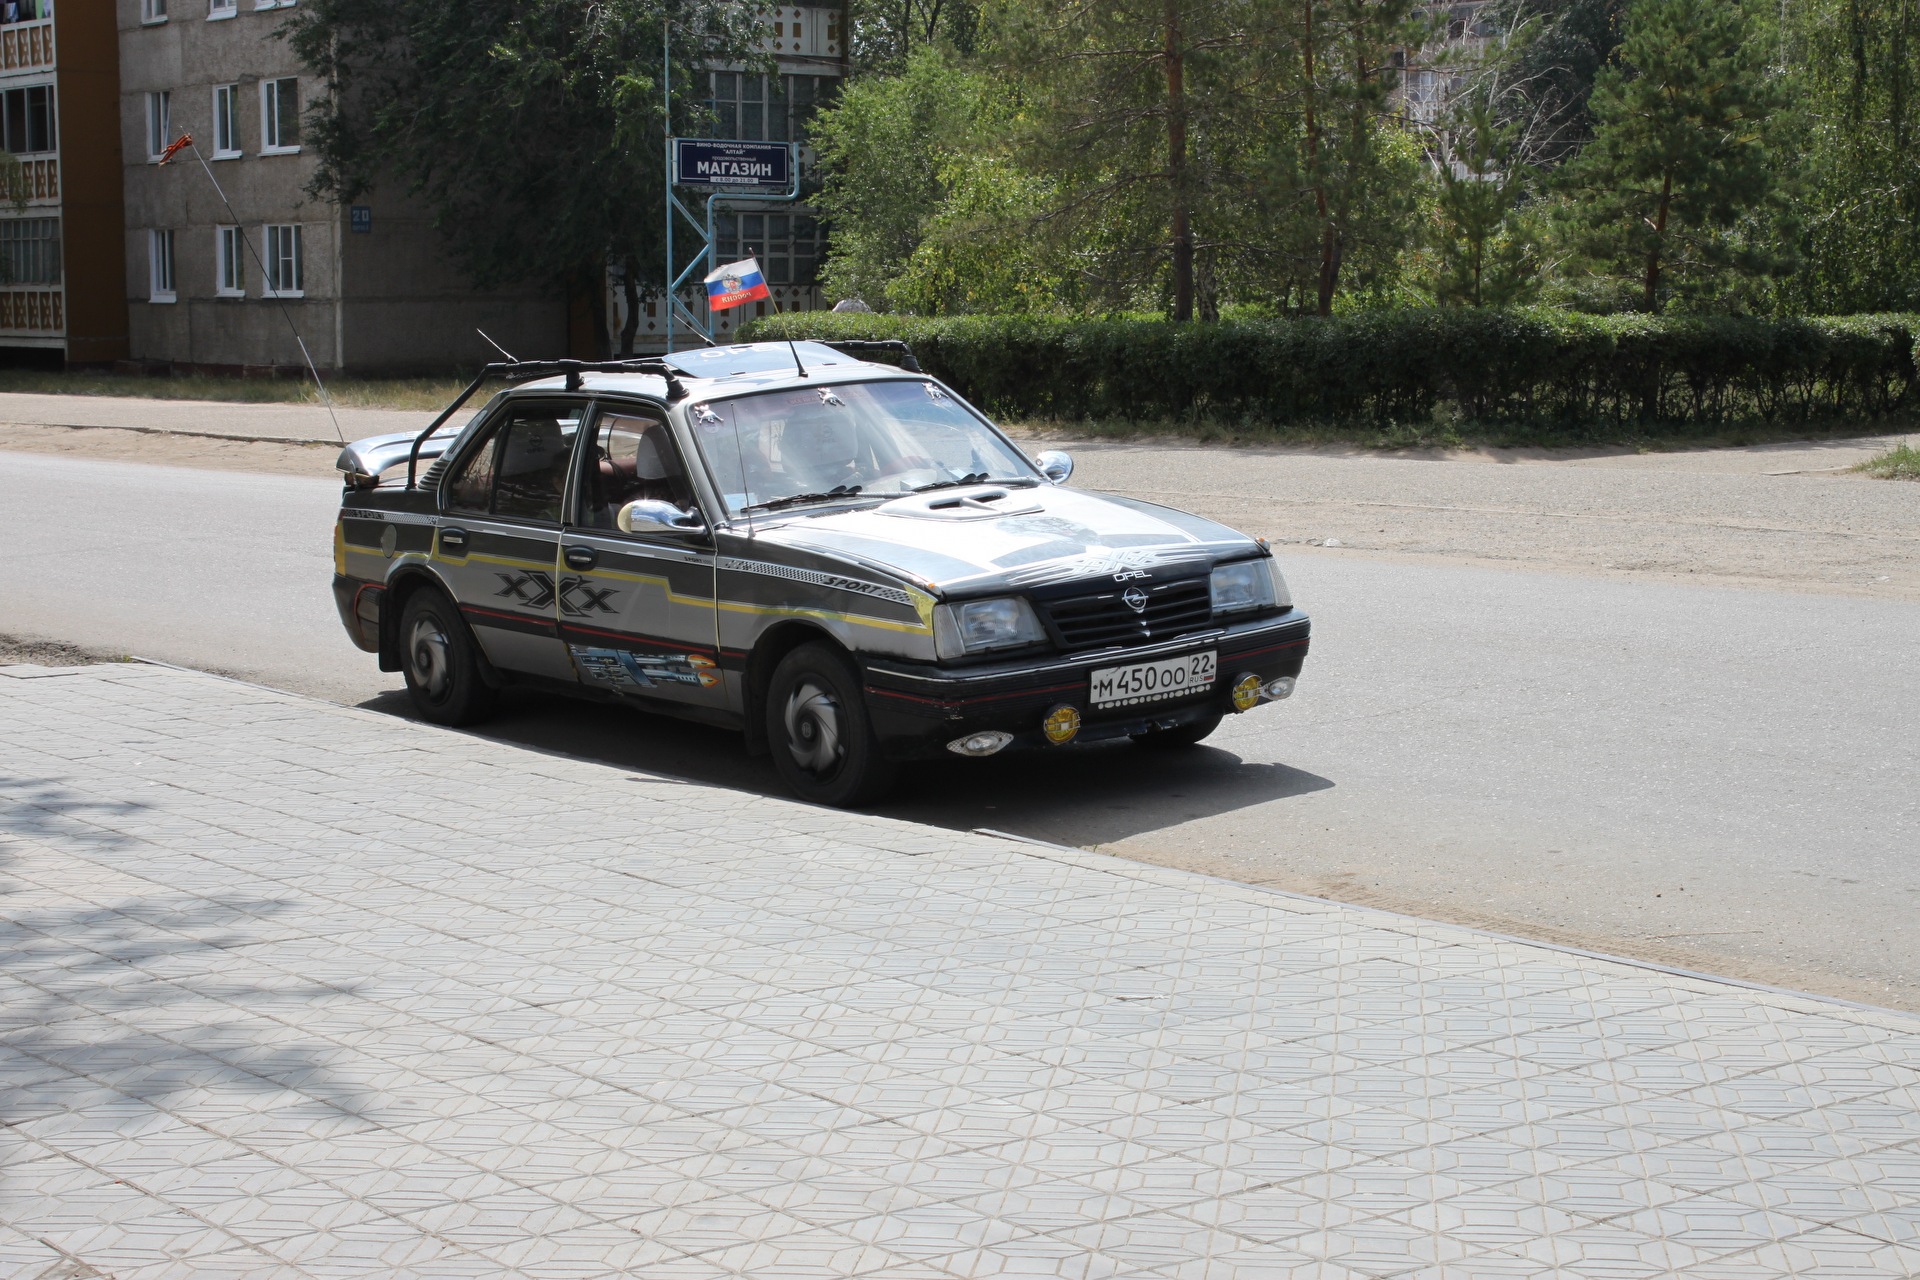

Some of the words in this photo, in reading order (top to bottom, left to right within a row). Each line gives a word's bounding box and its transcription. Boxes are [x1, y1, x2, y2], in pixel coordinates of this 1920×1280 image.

[697, 161, 772, 176] МАГАЗИН
[352, 210, 369, 222] 20
[355, 509, 384, 520] SPORT
[1113, 570, 1152, 582] OPEL
[824, 576, 882, 595] SPORT
[1191, 654, 1210, 675] 22
